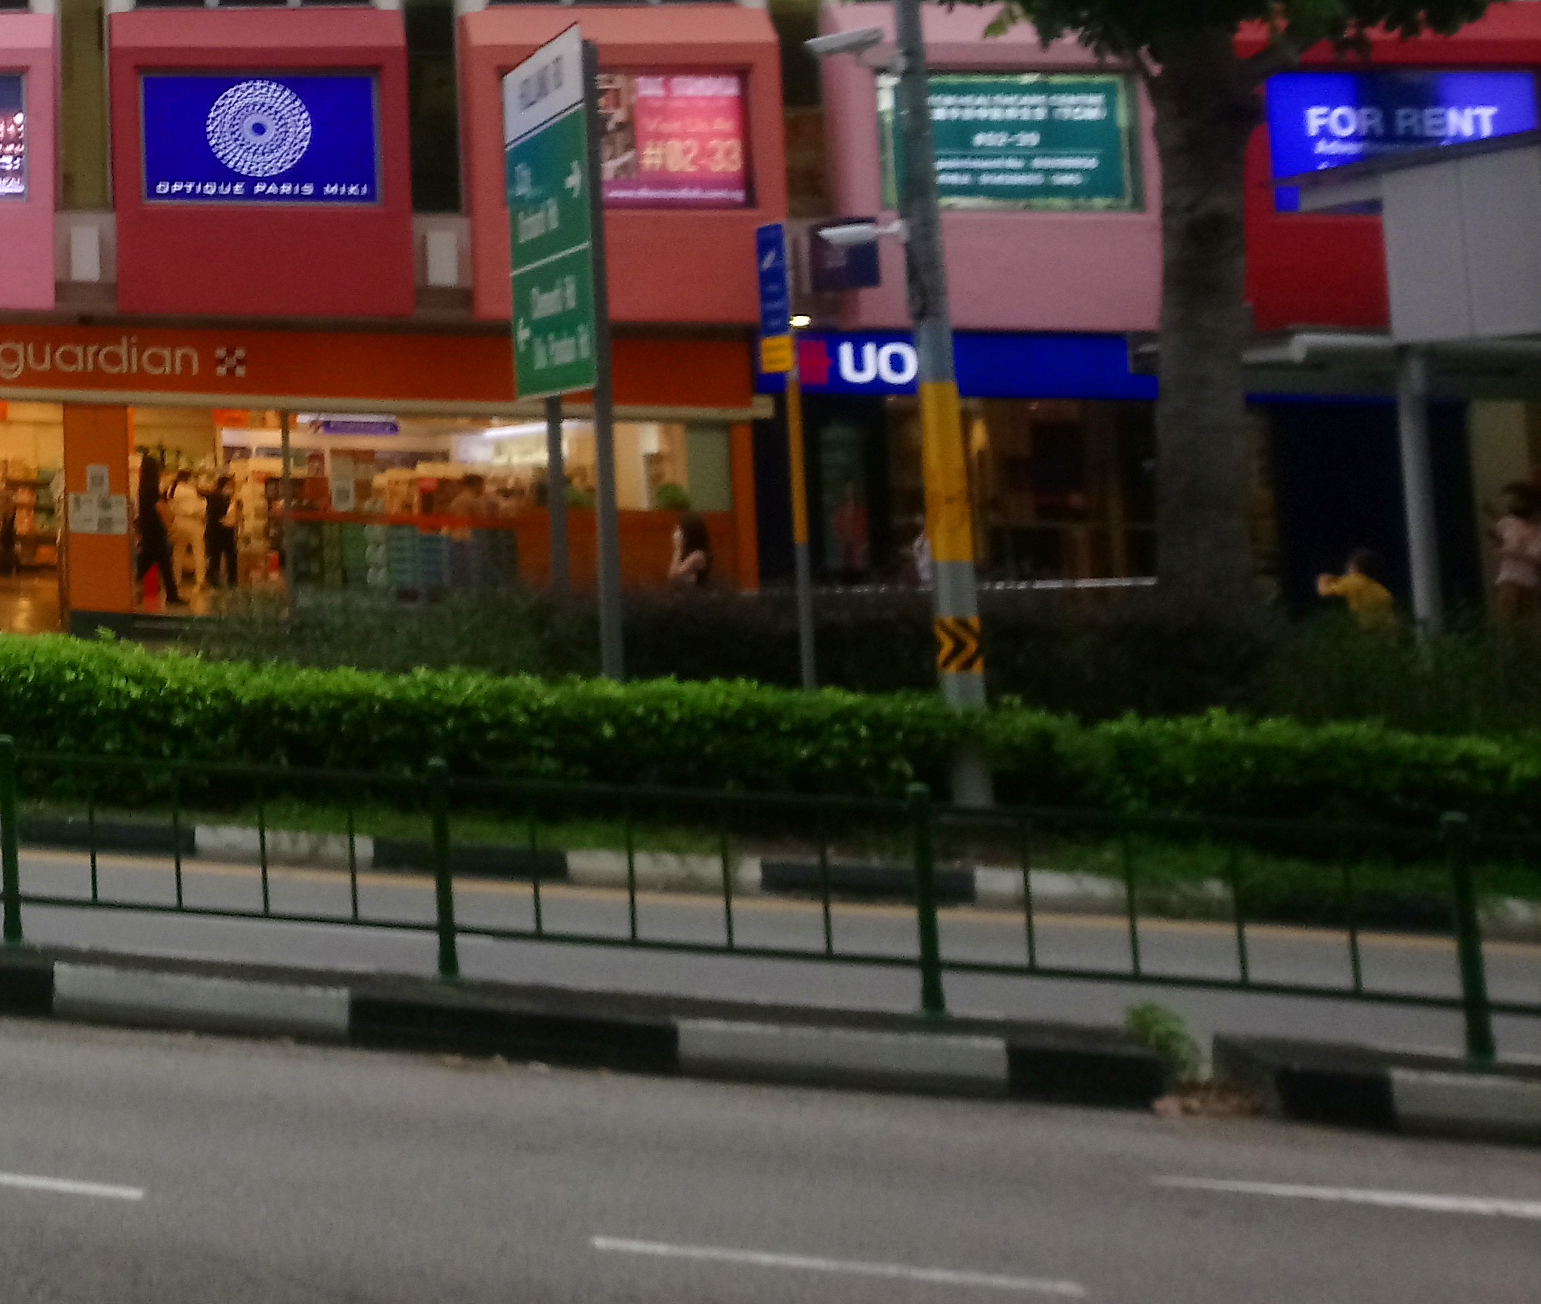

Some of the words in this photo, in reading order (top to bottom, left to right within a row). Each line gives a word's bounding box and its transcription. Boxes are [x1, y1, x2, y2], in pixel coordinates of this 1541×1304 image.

[1304, 106, 1384, 138] FOR
[1394, 106, 1499, 138] RENT
[642, 139, 743, 172] #02-33
[155, 180, 246, 196] OPTIQUE
[253, 181, 315, 196] PARIS
[323, 182, 368, 196] MIKI
[837, 341, 918, 385] UO
